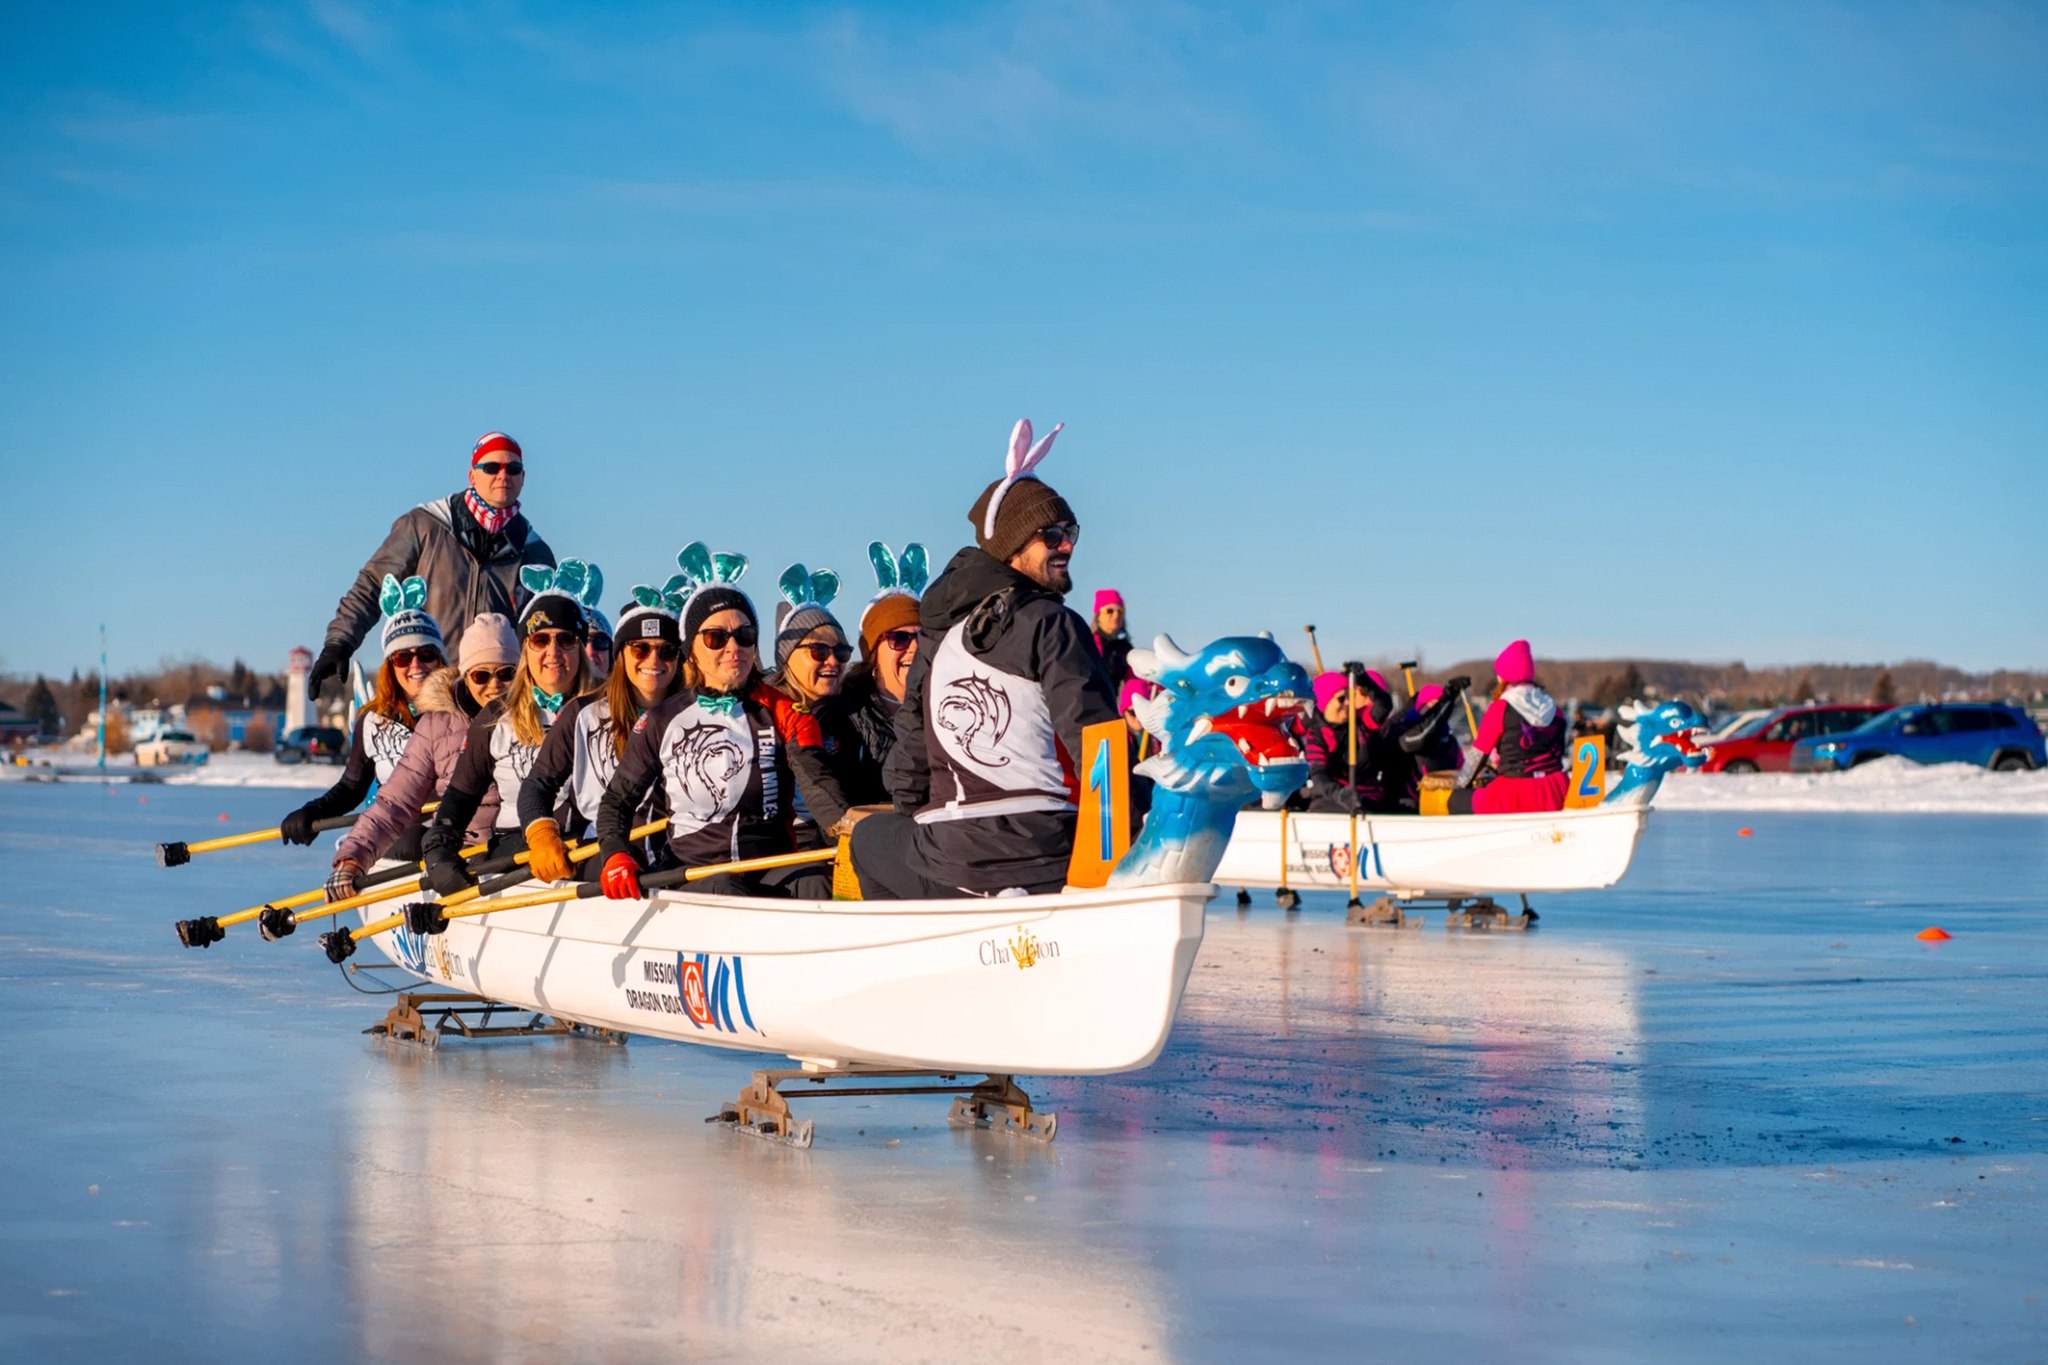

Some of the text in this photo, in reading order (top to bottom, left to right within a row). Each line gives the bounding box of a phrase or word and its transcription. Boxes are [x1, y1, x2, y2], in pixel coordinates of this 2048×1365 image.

[757, 726, 776, 769] TEAM
[1578, 742, 1600, 796] 2
[1090, 738, 1113, 861] 1
[979, 936, 1060, 968] Chapion
[643, 960, 679, 985] MISSION
[625, 988, 664, 1013] DRAGON
